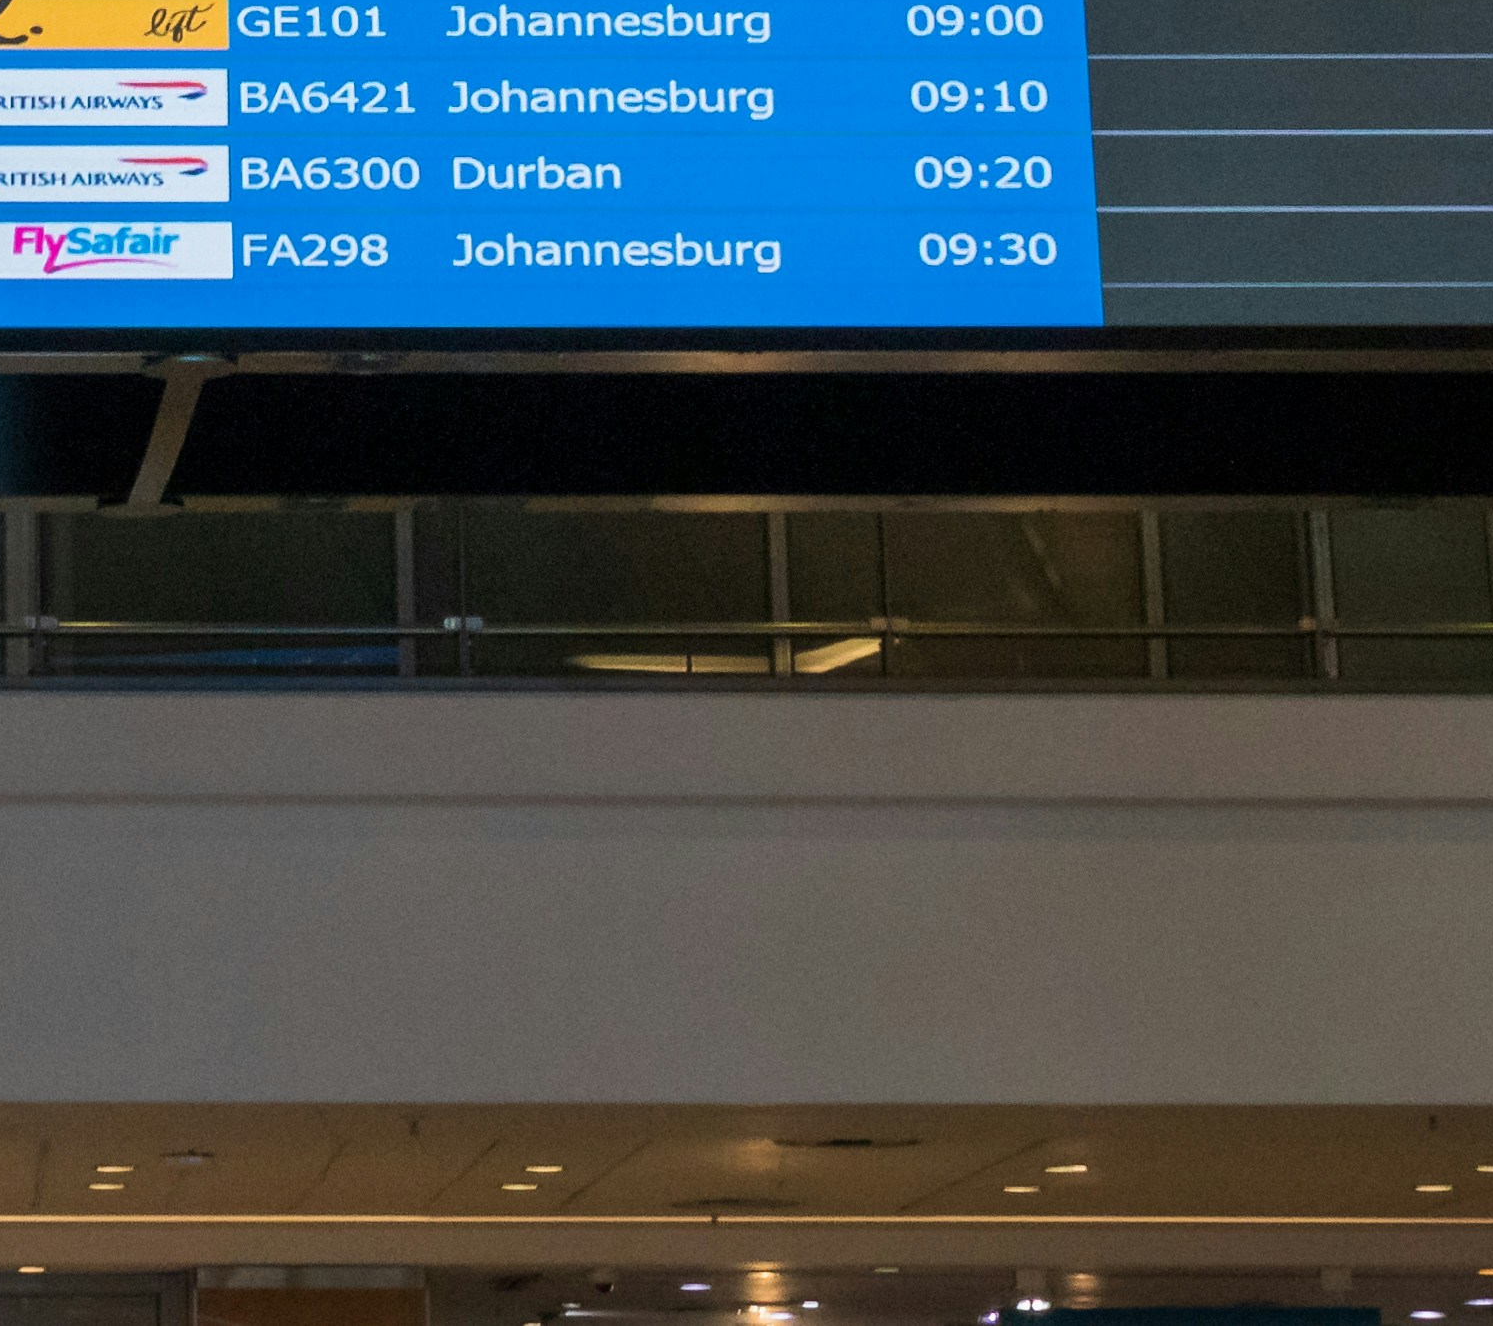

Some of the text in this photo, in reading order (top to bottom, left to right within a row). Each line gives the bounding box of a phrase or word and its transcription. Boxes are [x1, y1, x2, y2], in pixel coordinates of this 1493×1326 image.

[72, 172, 164, 186] AIRWAYS
[242, 157, 419, 189] BA6300
[454, 157, 620, 189] Durban
[916, 157, 1051, 188] 09:20
[13, 227, 1056, 274] FlySafair FA298 Johannesburg 09:30
